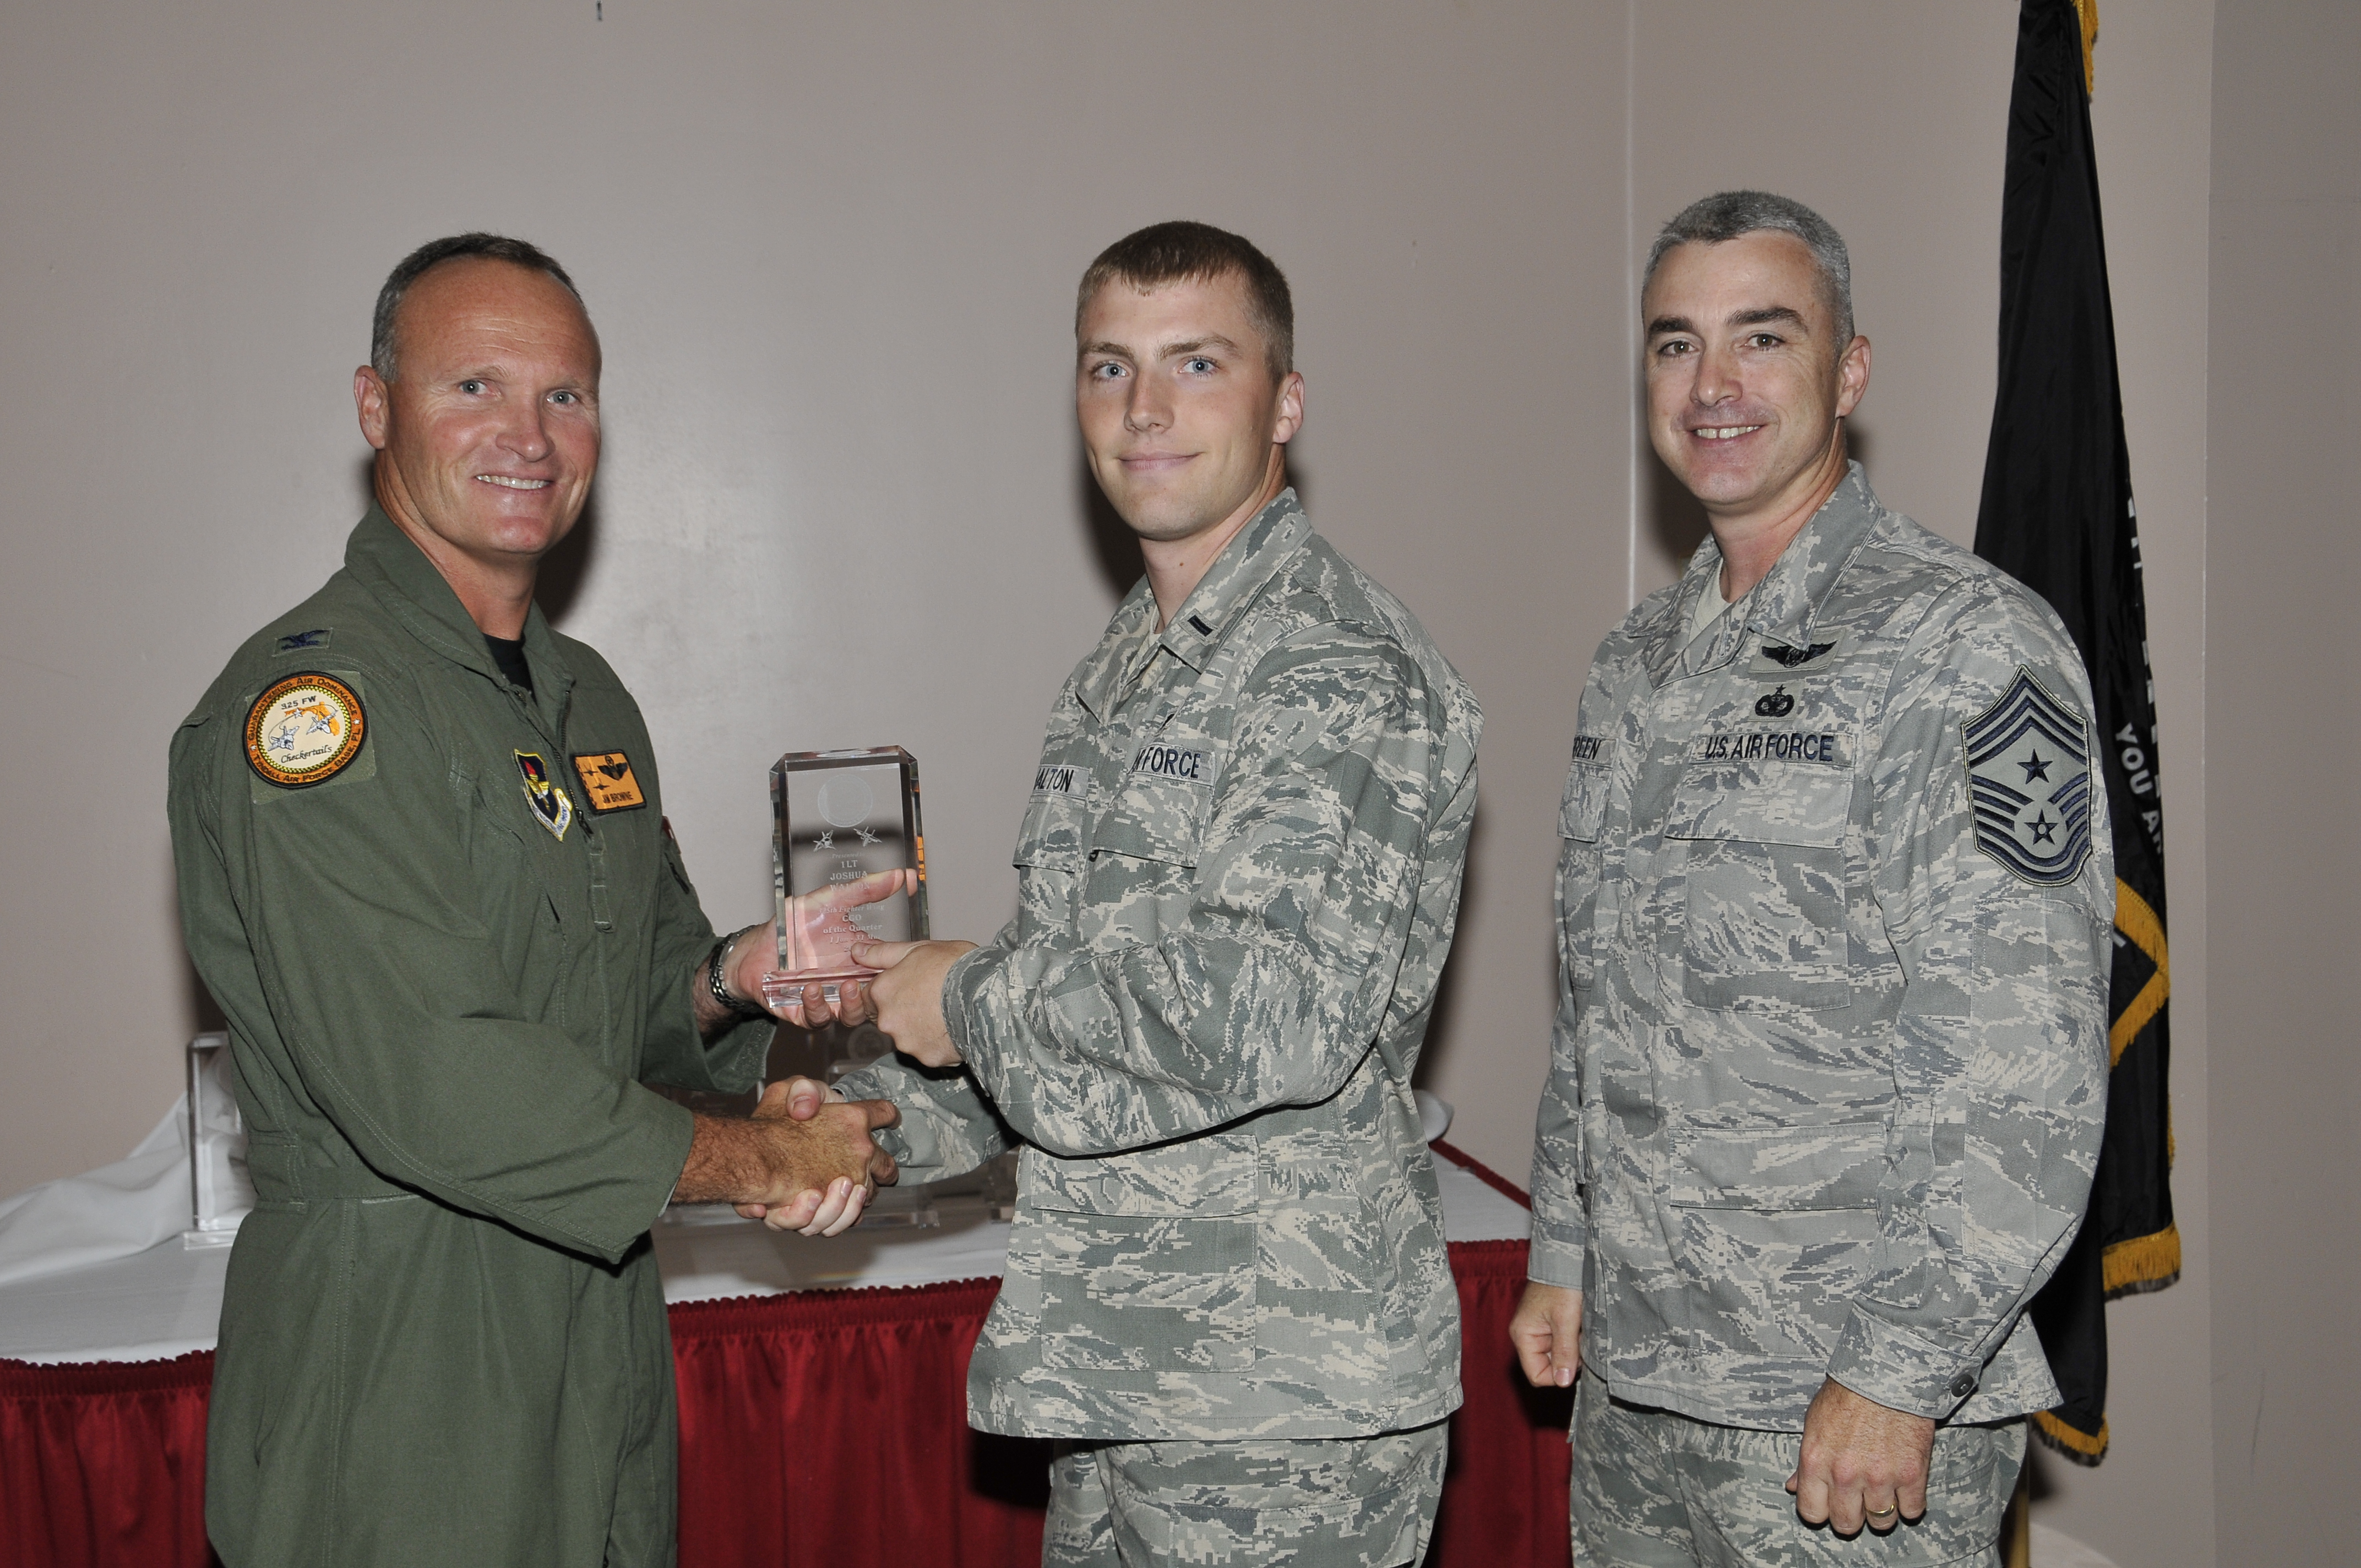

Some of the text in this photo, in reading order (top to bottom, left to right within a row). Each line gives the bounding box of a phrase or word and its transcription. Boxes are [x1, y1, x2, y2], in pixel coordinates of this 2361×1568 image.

[302, 695, 316, 704] FW
[317, 678, 357, 715] DOMINANCE
[281, 744, 332, 763] Checkertails
[303, 767, 333, 781] FORCE
[351, 728, 361, 741] FL
[1572, 736, 1602, 760] REEN
[1731, 734, 1762, 759] AIR
[1765, 733, 1834, 761] FORCE
[2115, 722, 2153, 794] YOU
[1141, 747, 1201, 779] FORCE
[830, 871, 868, 880] JOSHUA
